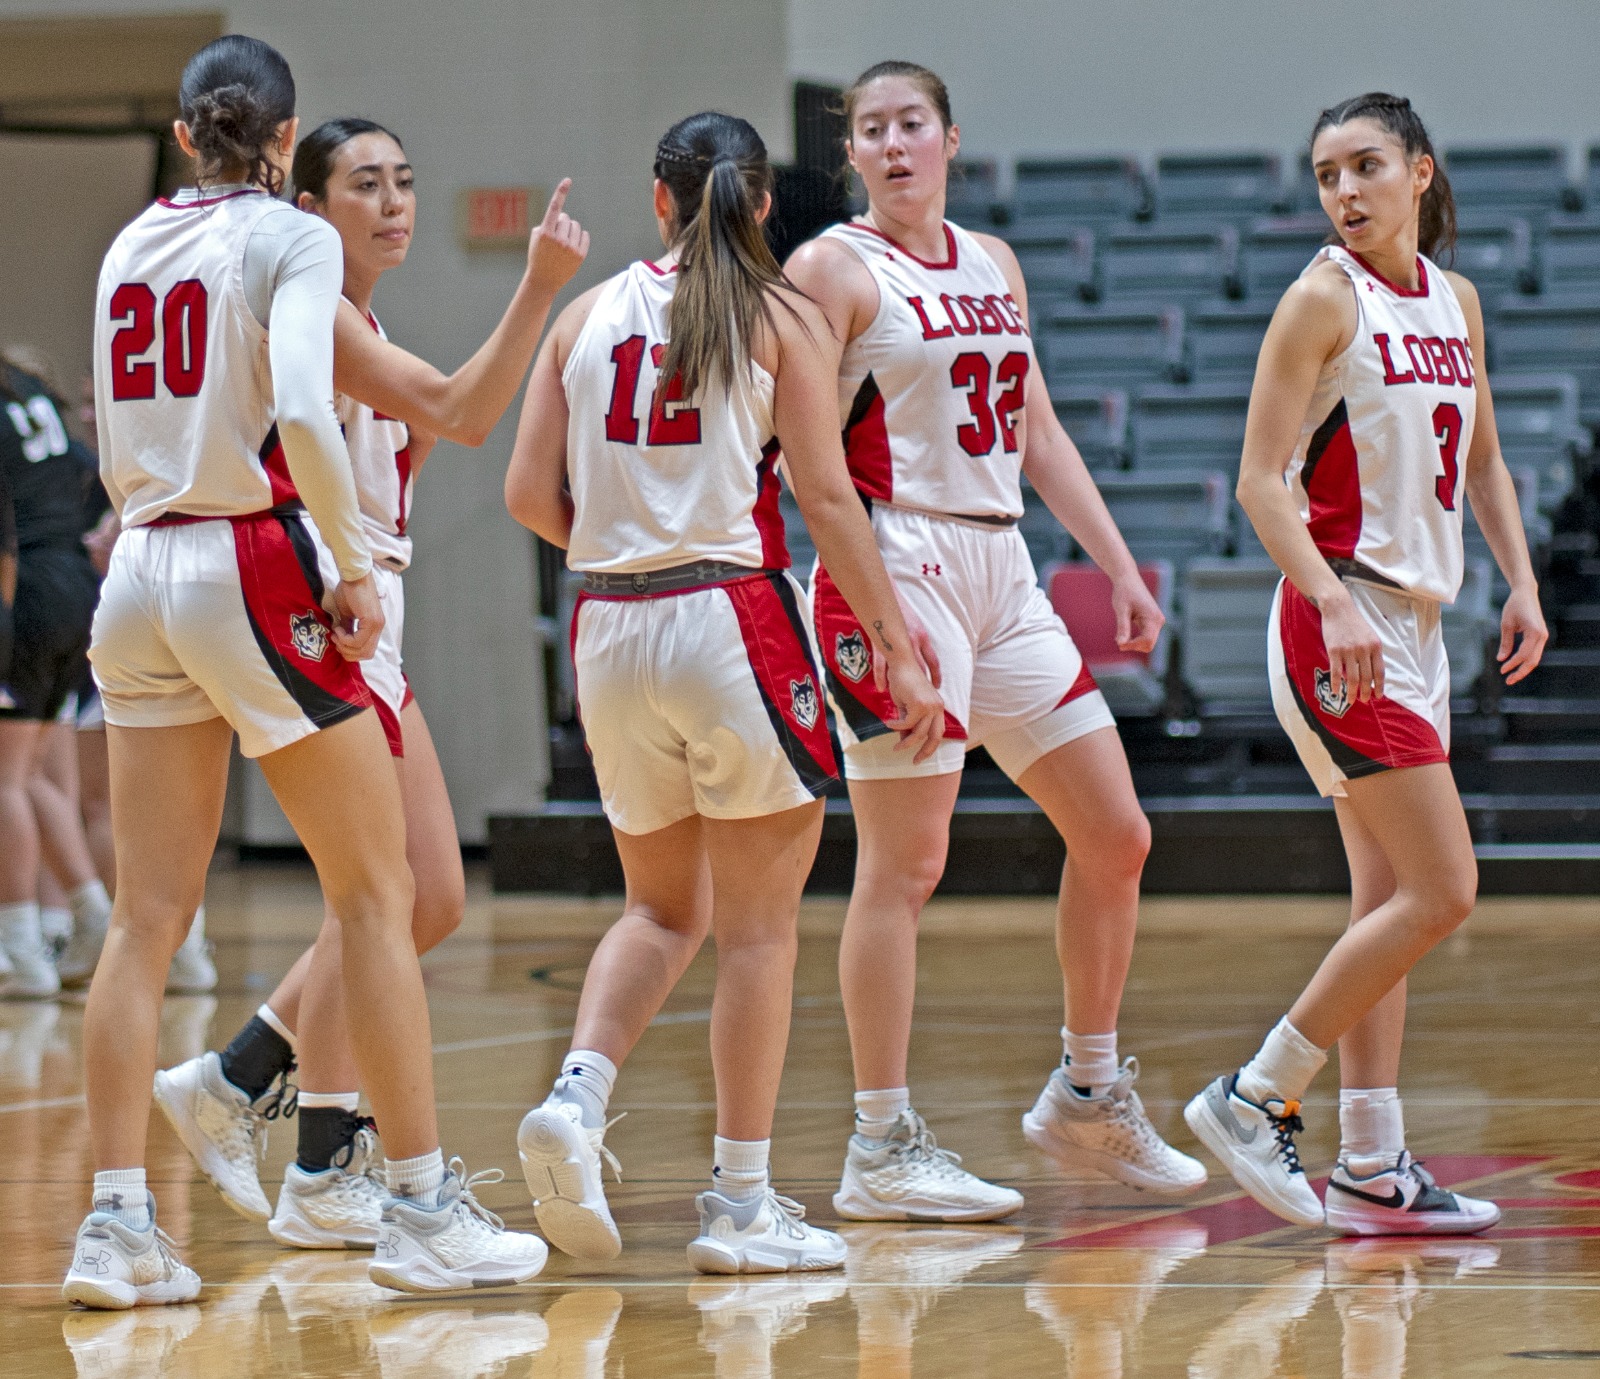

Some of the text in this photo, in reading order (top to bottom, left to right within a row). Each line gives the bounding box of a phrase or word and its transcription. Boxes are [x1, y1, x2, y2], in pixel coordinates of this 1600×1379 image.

[110, 278, 208, 402] 20
[605, 334, 702, 446] 12
[950, 351, 1030, 457] 32
[1432, 402, 1463, 511] 3
